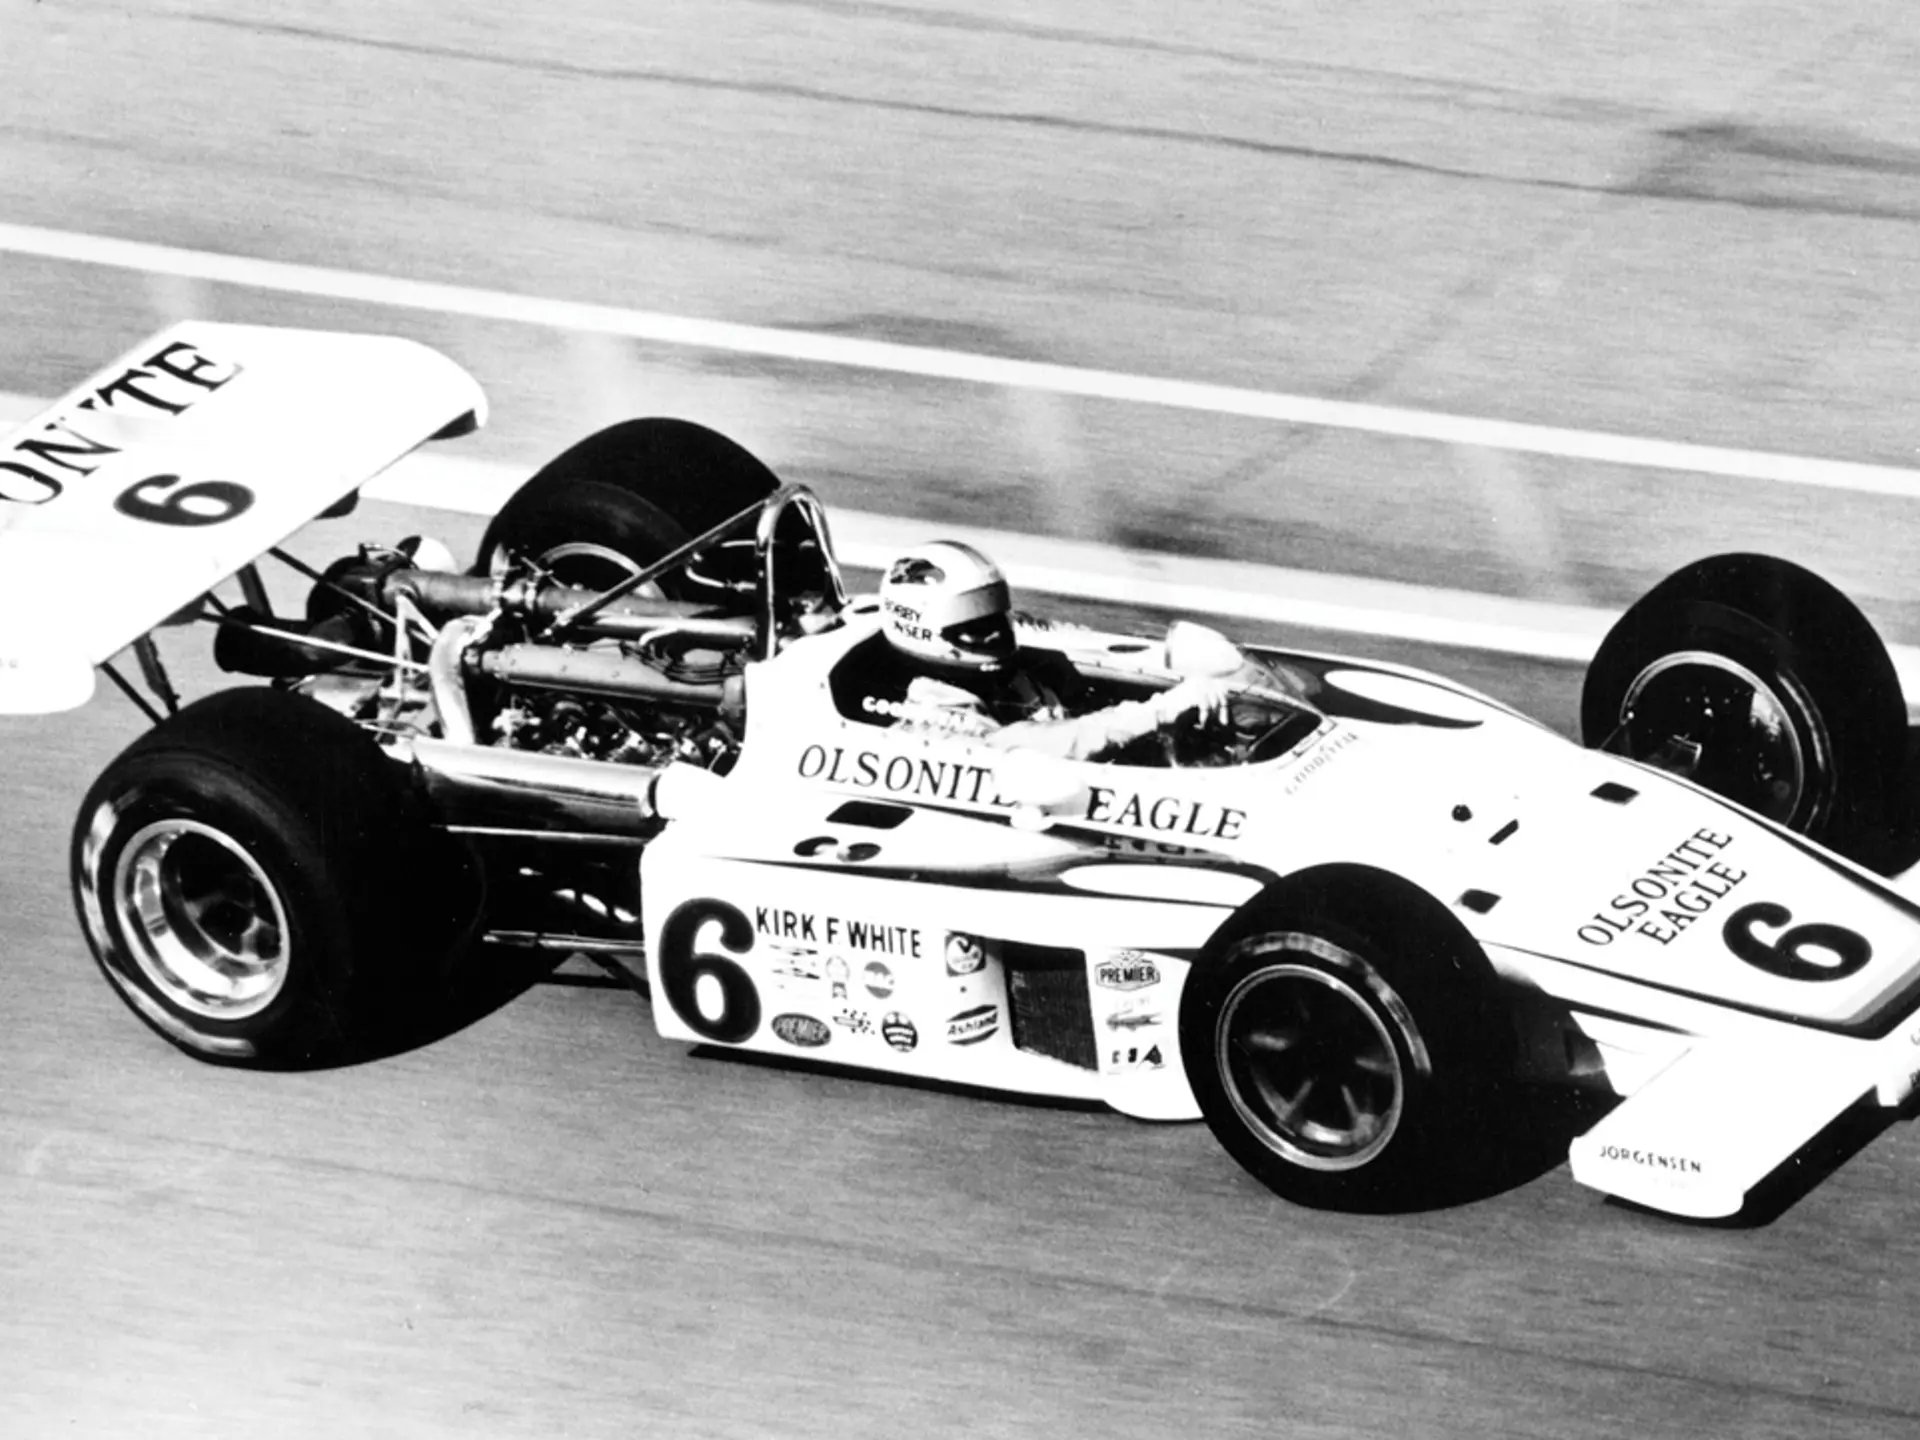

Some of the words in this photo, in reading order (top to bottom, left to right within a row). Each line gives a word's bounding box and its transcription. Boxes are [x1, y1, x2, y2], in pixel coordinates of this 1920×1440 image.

[113, 474, 256, 527] 6
[1086, 786, 1247, 840] EAGLE
[1577, 828, 1733, 946] OLSONITE
[1636, 862, 1747, 946] EAGLE
[756, 906, 818, 941] KIRK
[847, 921, 921, 958] WHITE
[1722, 901, 1872, 981] 6
[658, 897, 761, 1044] 6
[1099, 964, 1157, 984] PREMIER
[1600, 1146, 1701, 1173] JORGENSEN
